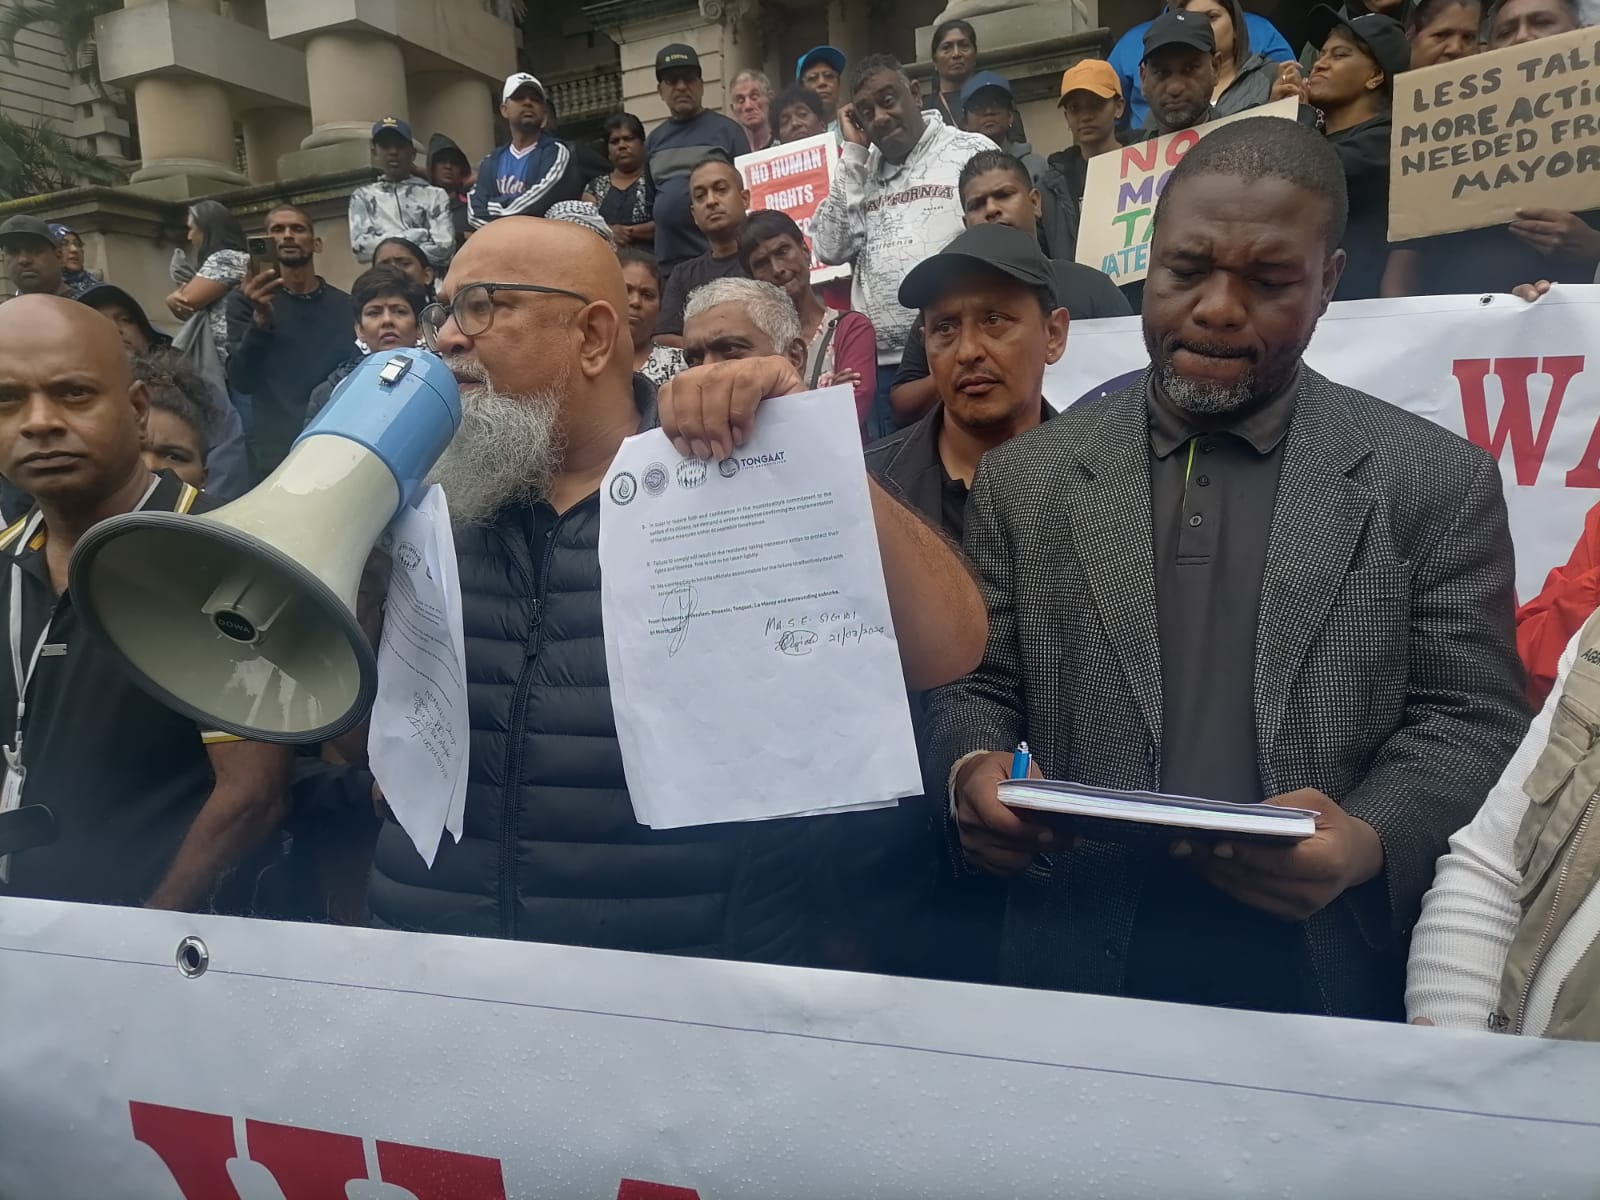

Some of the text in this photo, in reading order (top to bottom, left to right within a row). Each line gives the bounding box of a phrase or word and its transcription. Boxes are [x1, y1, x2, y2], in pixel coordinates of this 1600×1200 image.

[1413, 40, 1600, 112] LESS TAL
[1400, 79, 1600, 147] MORE ACTi
[751, 149, 822, 184] NO HUMAN
[1120, 129, 1200, 179] NO
[1402, 113, 1600, 176] NEEDED FR
[765, 183, 814, 210] RIGHTS
[740, 451, 785, 467] TONGAAT
